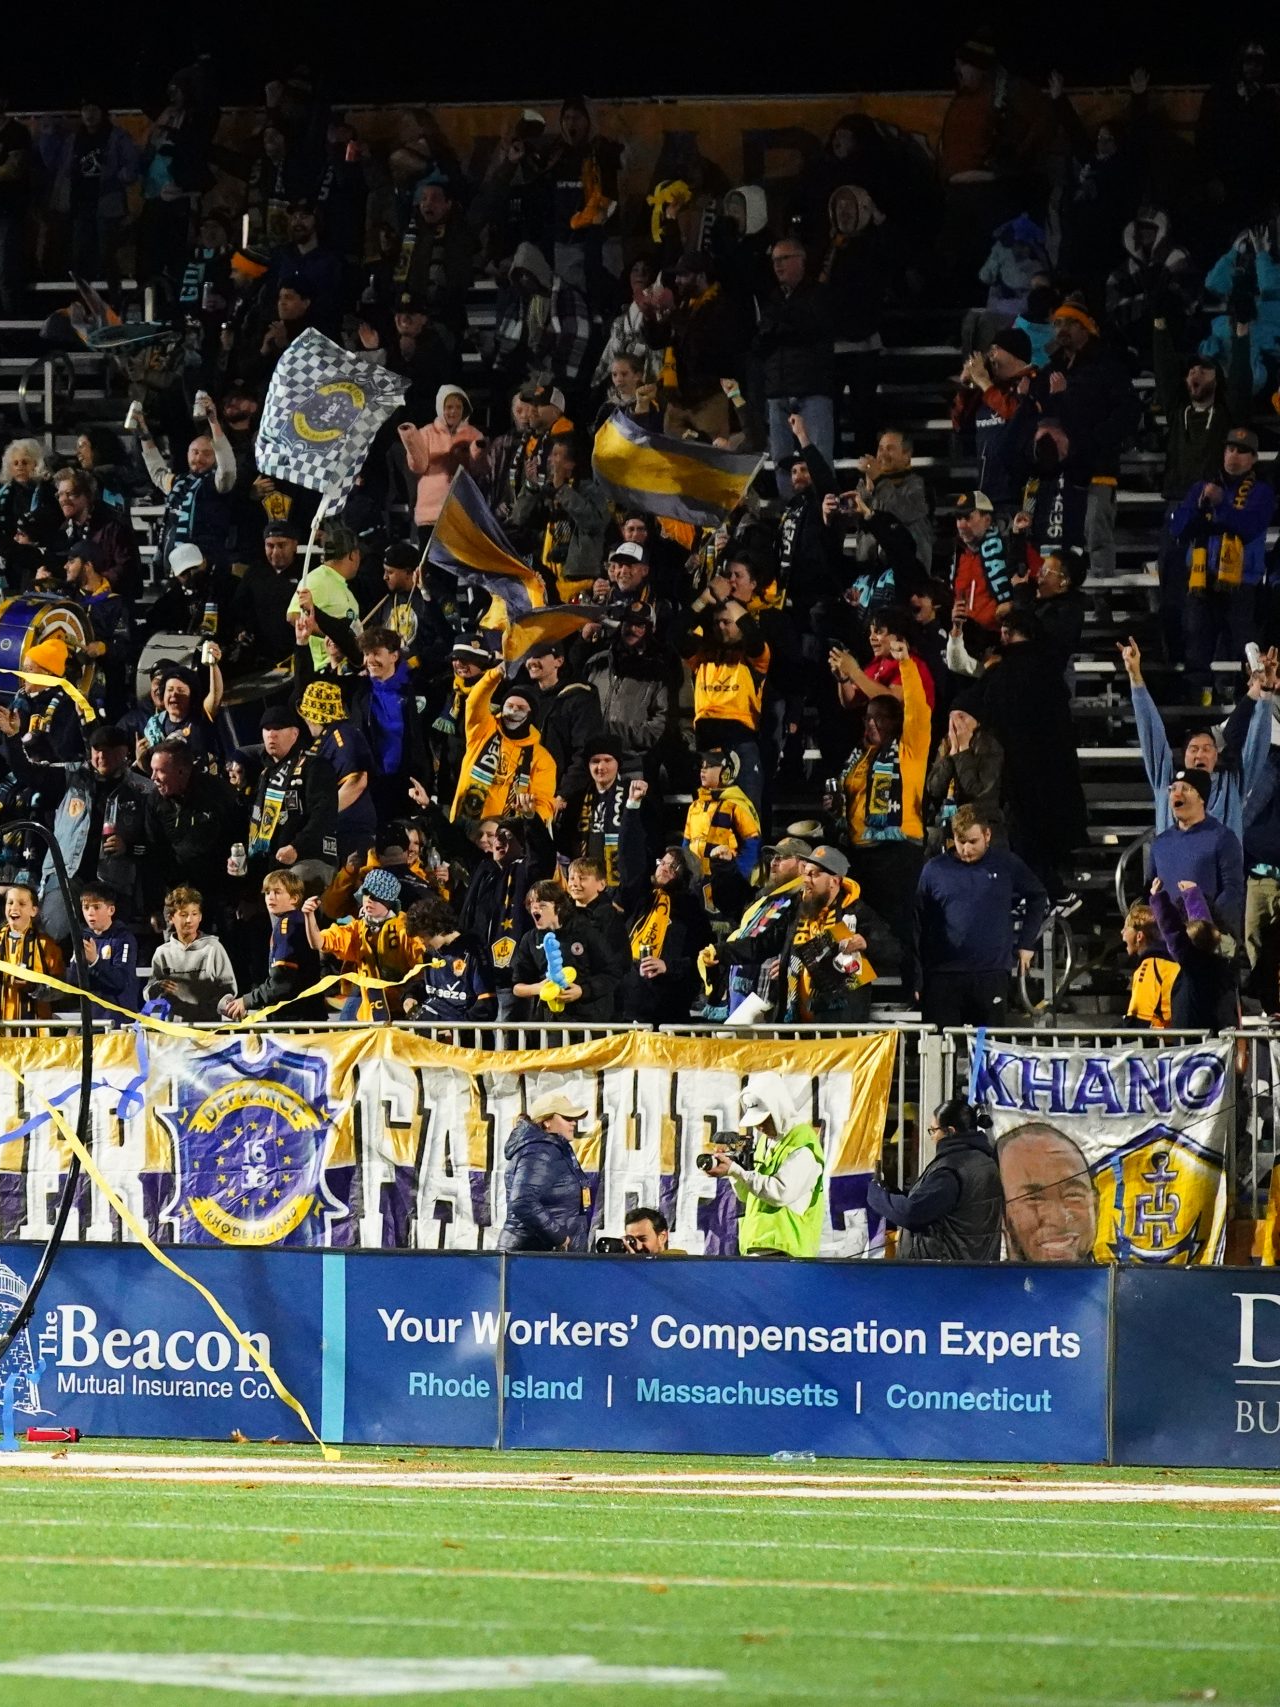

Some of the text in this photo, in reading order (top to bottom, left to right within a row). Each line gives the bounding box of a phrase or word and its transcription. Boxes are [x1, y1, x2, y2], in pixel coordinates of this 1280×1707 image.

[972, 1050, 1225, 1115] KHANO
[203, 1087, 303, 1124] DEFIANCE
[243, 1139, 267, 1164] 16
[204, 1206, 298, 1240] RHODE ISLAND
[39, 1311, 59, 1356] The
[55, 1305, 275, 1372] Beacon
[377, 1309, 463, 1345] Your
[650, 1314, 927, 1358] Compensation
[939, 1320, 1082, 1364] Experts
[58, 1372, 276, 1400] Mutual Insurance Co.
[408, 1372, 1052, 1413] Rhode Island Massachusetts Connecticut
